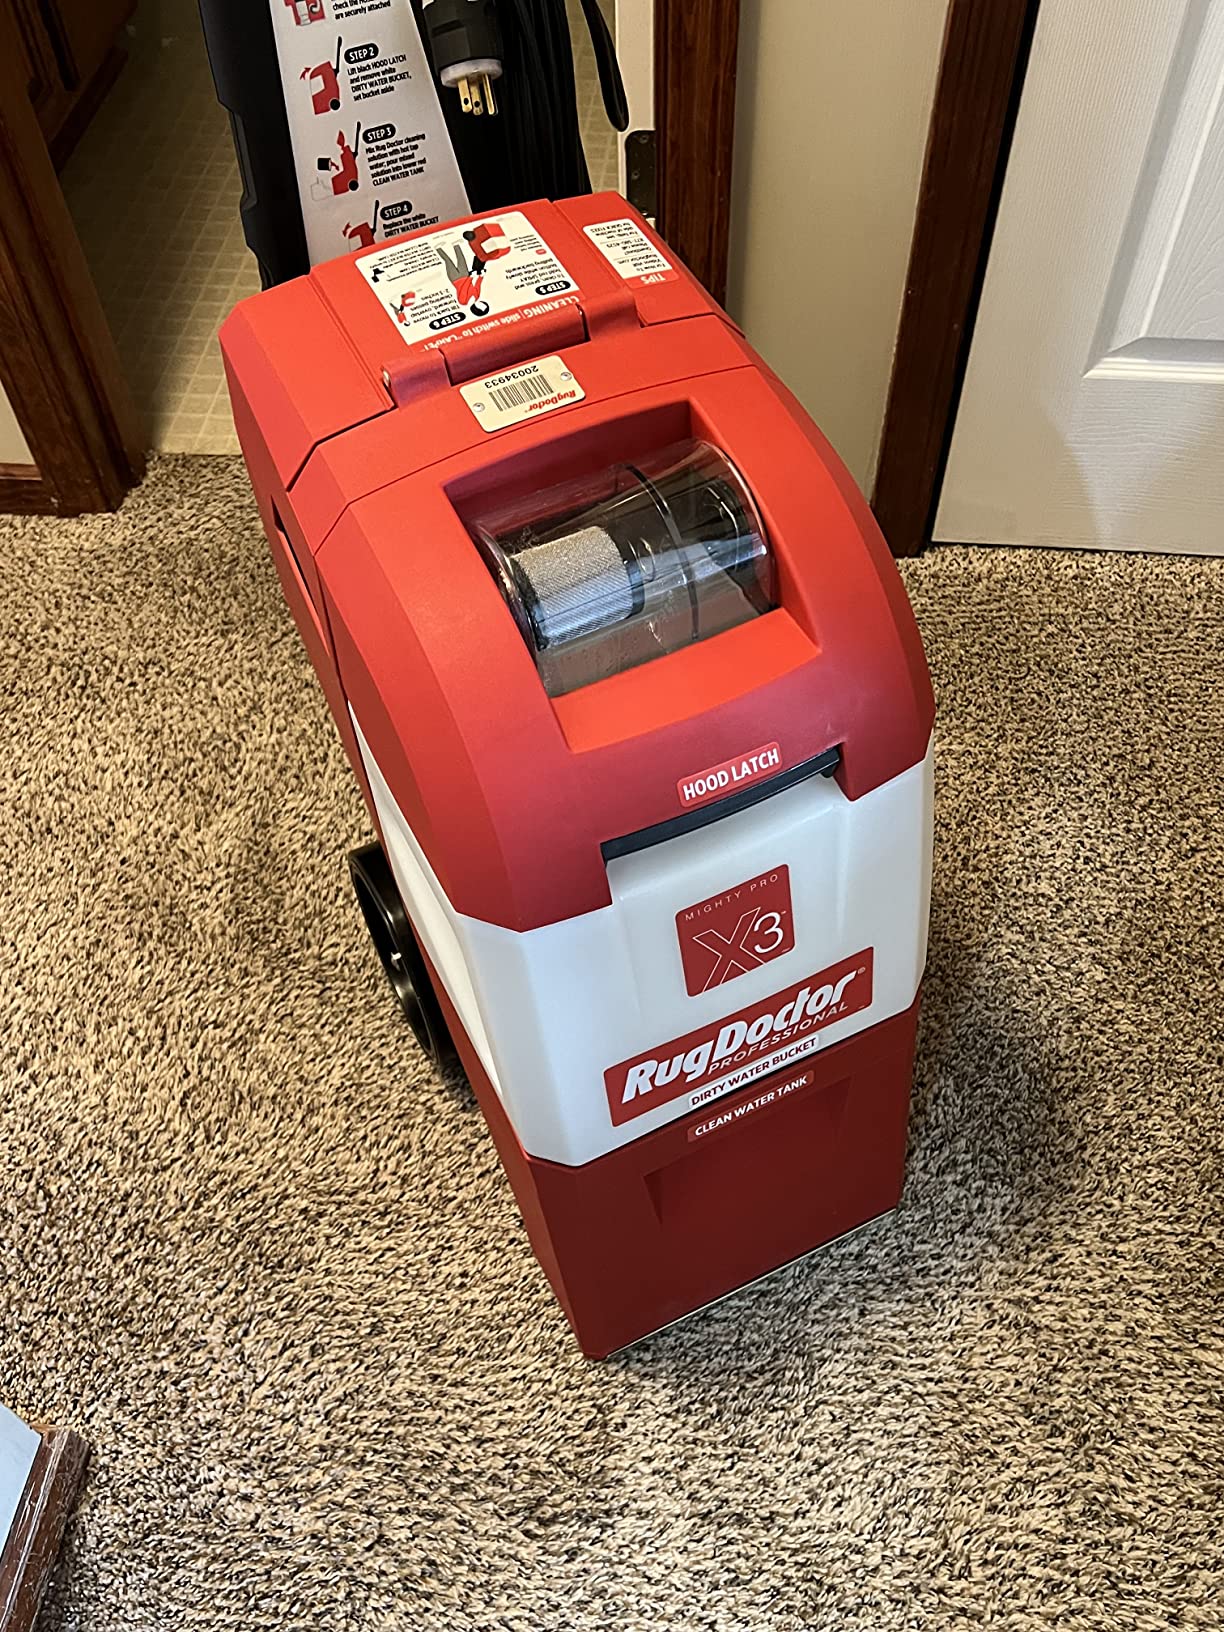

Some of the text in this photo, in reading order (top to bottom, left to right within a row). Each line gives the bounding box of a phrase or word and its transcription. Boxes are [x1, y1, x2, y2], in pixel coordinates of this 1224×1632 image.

[347, 54, 407, 76] Lift black HOOD LATCH
[349, 46, 374, 62] STEP 2
[351, 82, 368, 92] DIRTY
[368, 77, 388, 88] WATER
[368, 127, 392, 141] STEP 3
[384, 204, 408, 218] STEP 4
[540, 281, 566, 294] STEP 5
[640, 272, 666, 284] TIPS
[500, 312, 521, 324] slide
[523, 296, 580, 318] CLEANING
[433, 313, 460, 328] STEP 6
[472, 320, 500, 334] switch
[484, 364, 539, 389] 20034933
[528, 390, 576, 412] RugDoctor
[682, 748, 780, 801] HOOD LATCH
[685, 874, 778, 922] MIGHTY PRO
[621, 970, 857, 1104] RugDoctor
[708, 1001, 848, 1076] PROFESSIONAL
[691, 1036, 818, 1106] DIRTY WATER BUCKET
[694, 1075, 808, 1137] CLEAN WATER TANK
